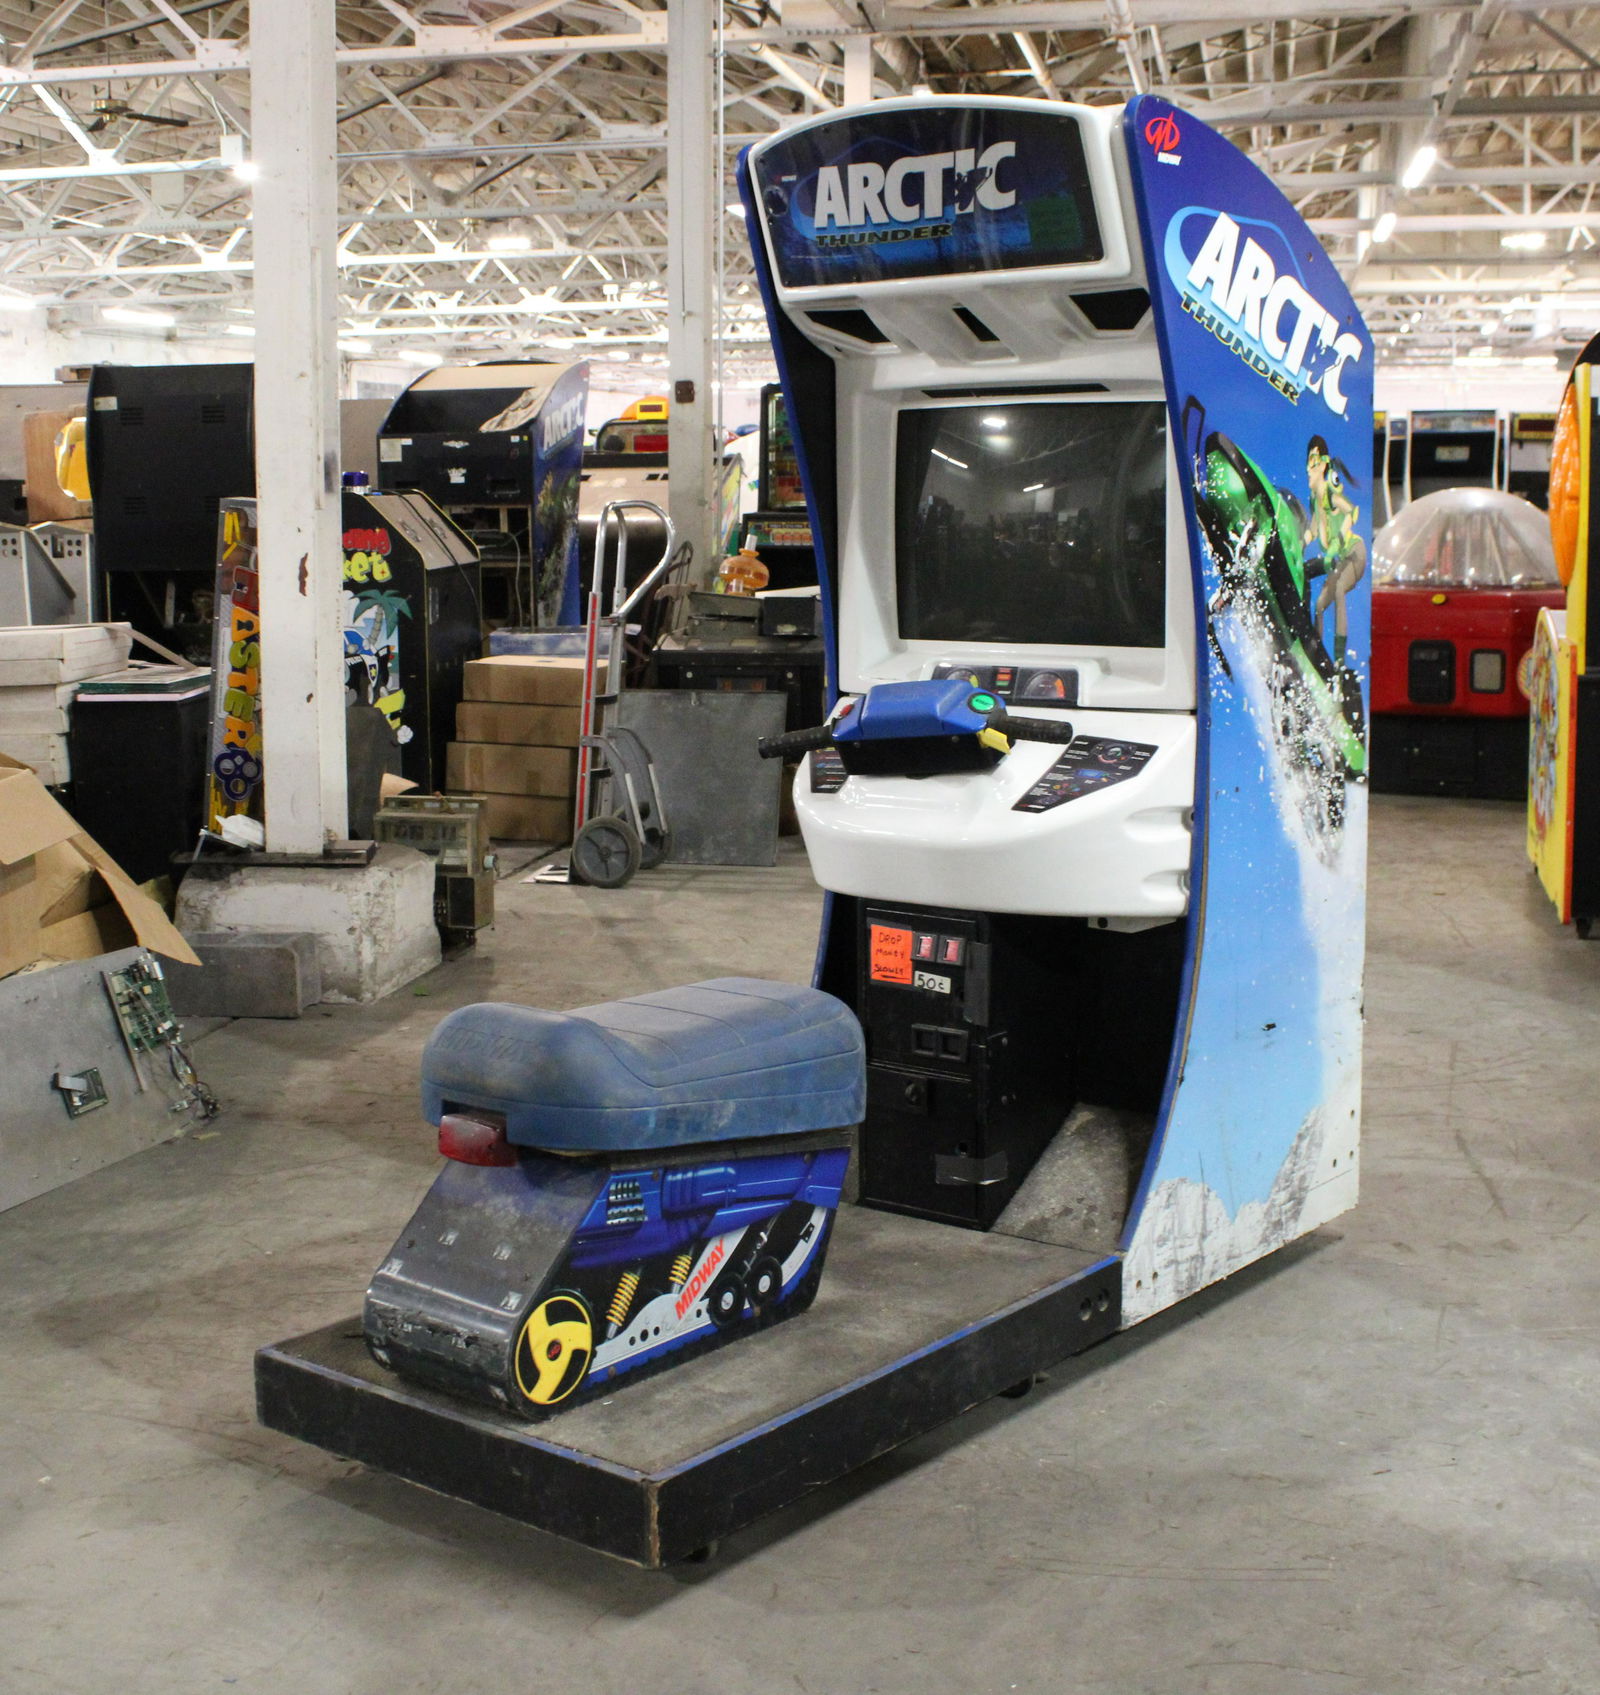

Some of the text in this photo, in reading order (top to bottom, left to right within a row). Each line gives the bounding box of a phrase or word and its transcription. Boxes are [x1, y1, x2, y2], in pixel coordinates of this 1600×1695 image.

[814, 141, 1016, 228] ARCTIC
[816, 222, 953, 247] THUNDER
[1182, 290, 1300, 406] THUNDER
[1186, 212, 1363, 415] ARCTIC
[674, 1237, 726, 1320] MIDWAY
